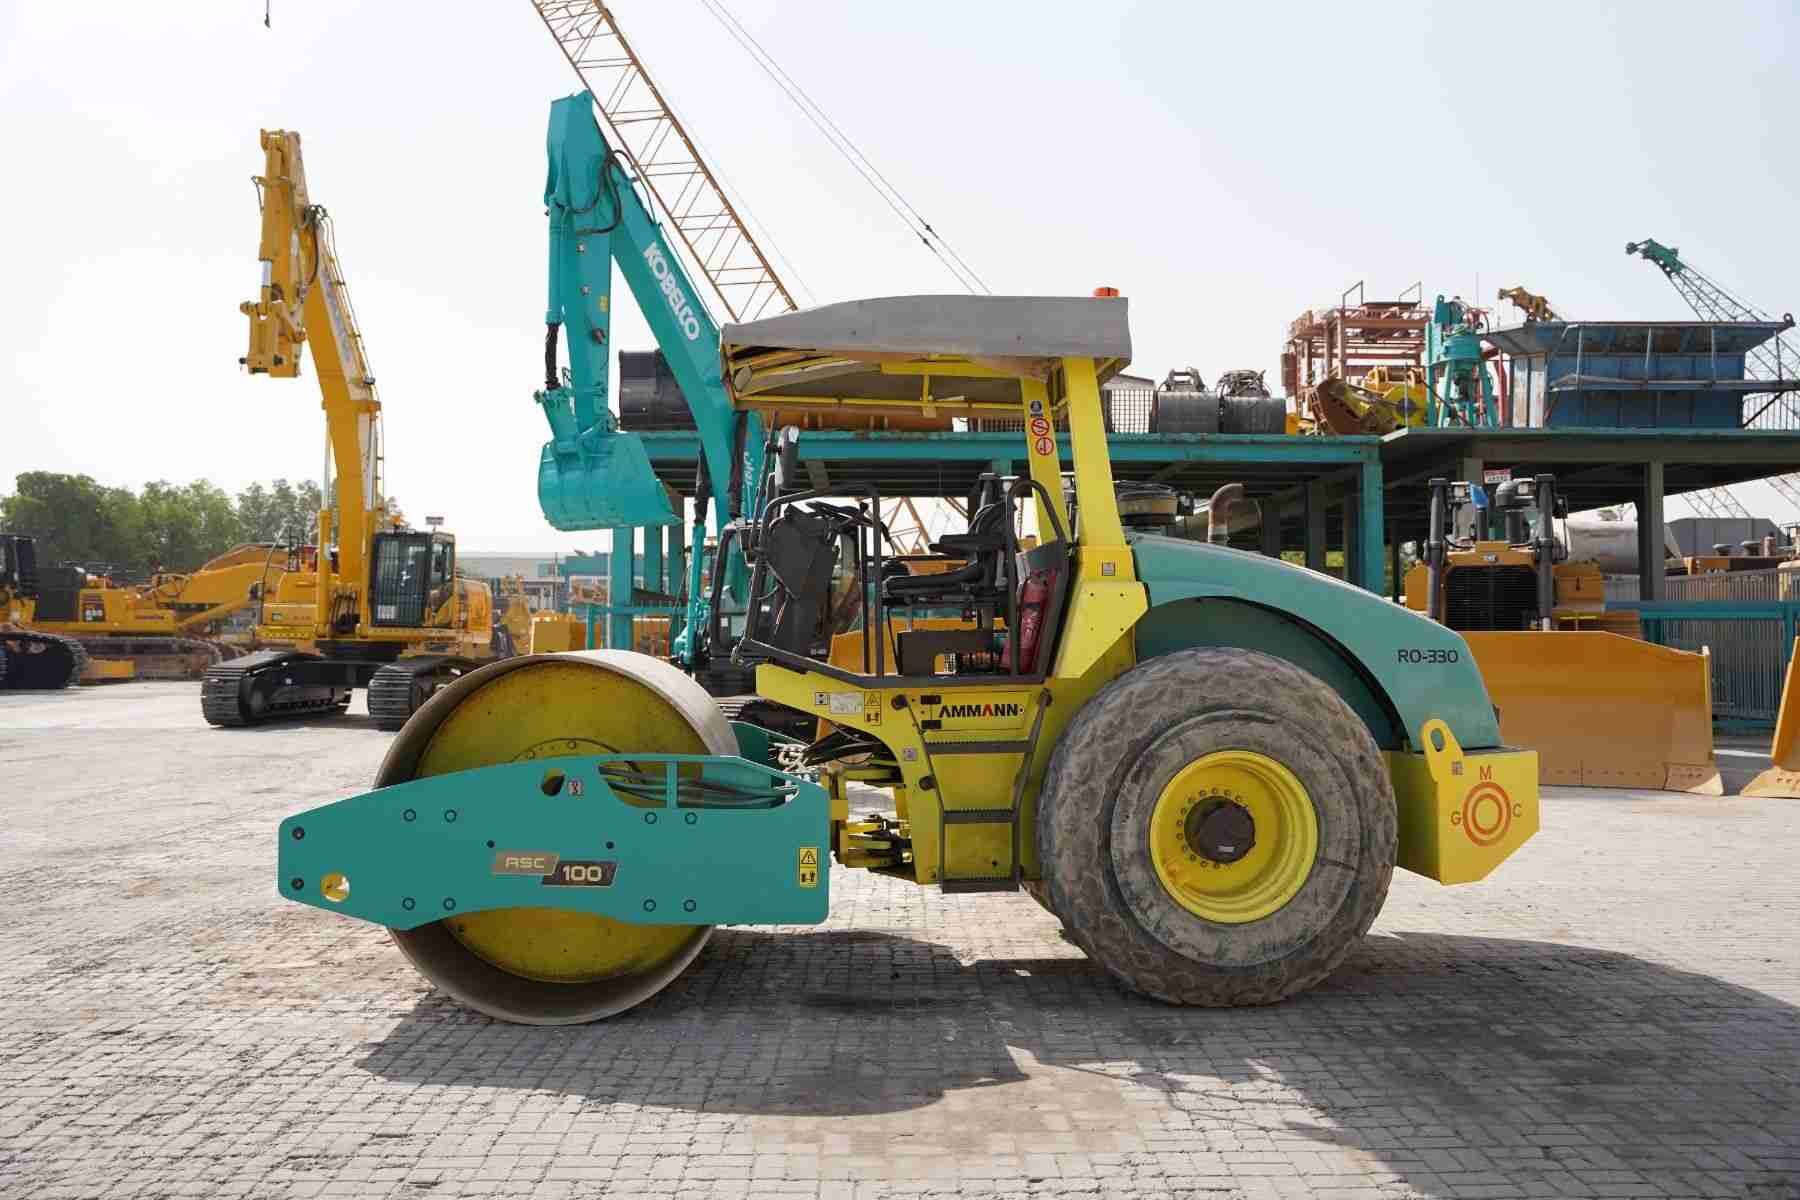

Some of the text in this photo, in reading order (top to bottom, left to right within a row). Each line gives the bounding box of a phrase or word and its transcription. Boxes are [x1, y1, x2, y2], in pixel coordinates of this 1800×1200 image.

[643, 240, 700, 341] KOBELCO
[1397, 648, 1459, 664] RO-330
[938, 703, 1018, 719] AMMANN
[1479, 764, 1492, 780] M
[1450, 811, 1461, 826] G
[1512, 803, 1522, 818] C
[562, 866, 602, 882] 100
